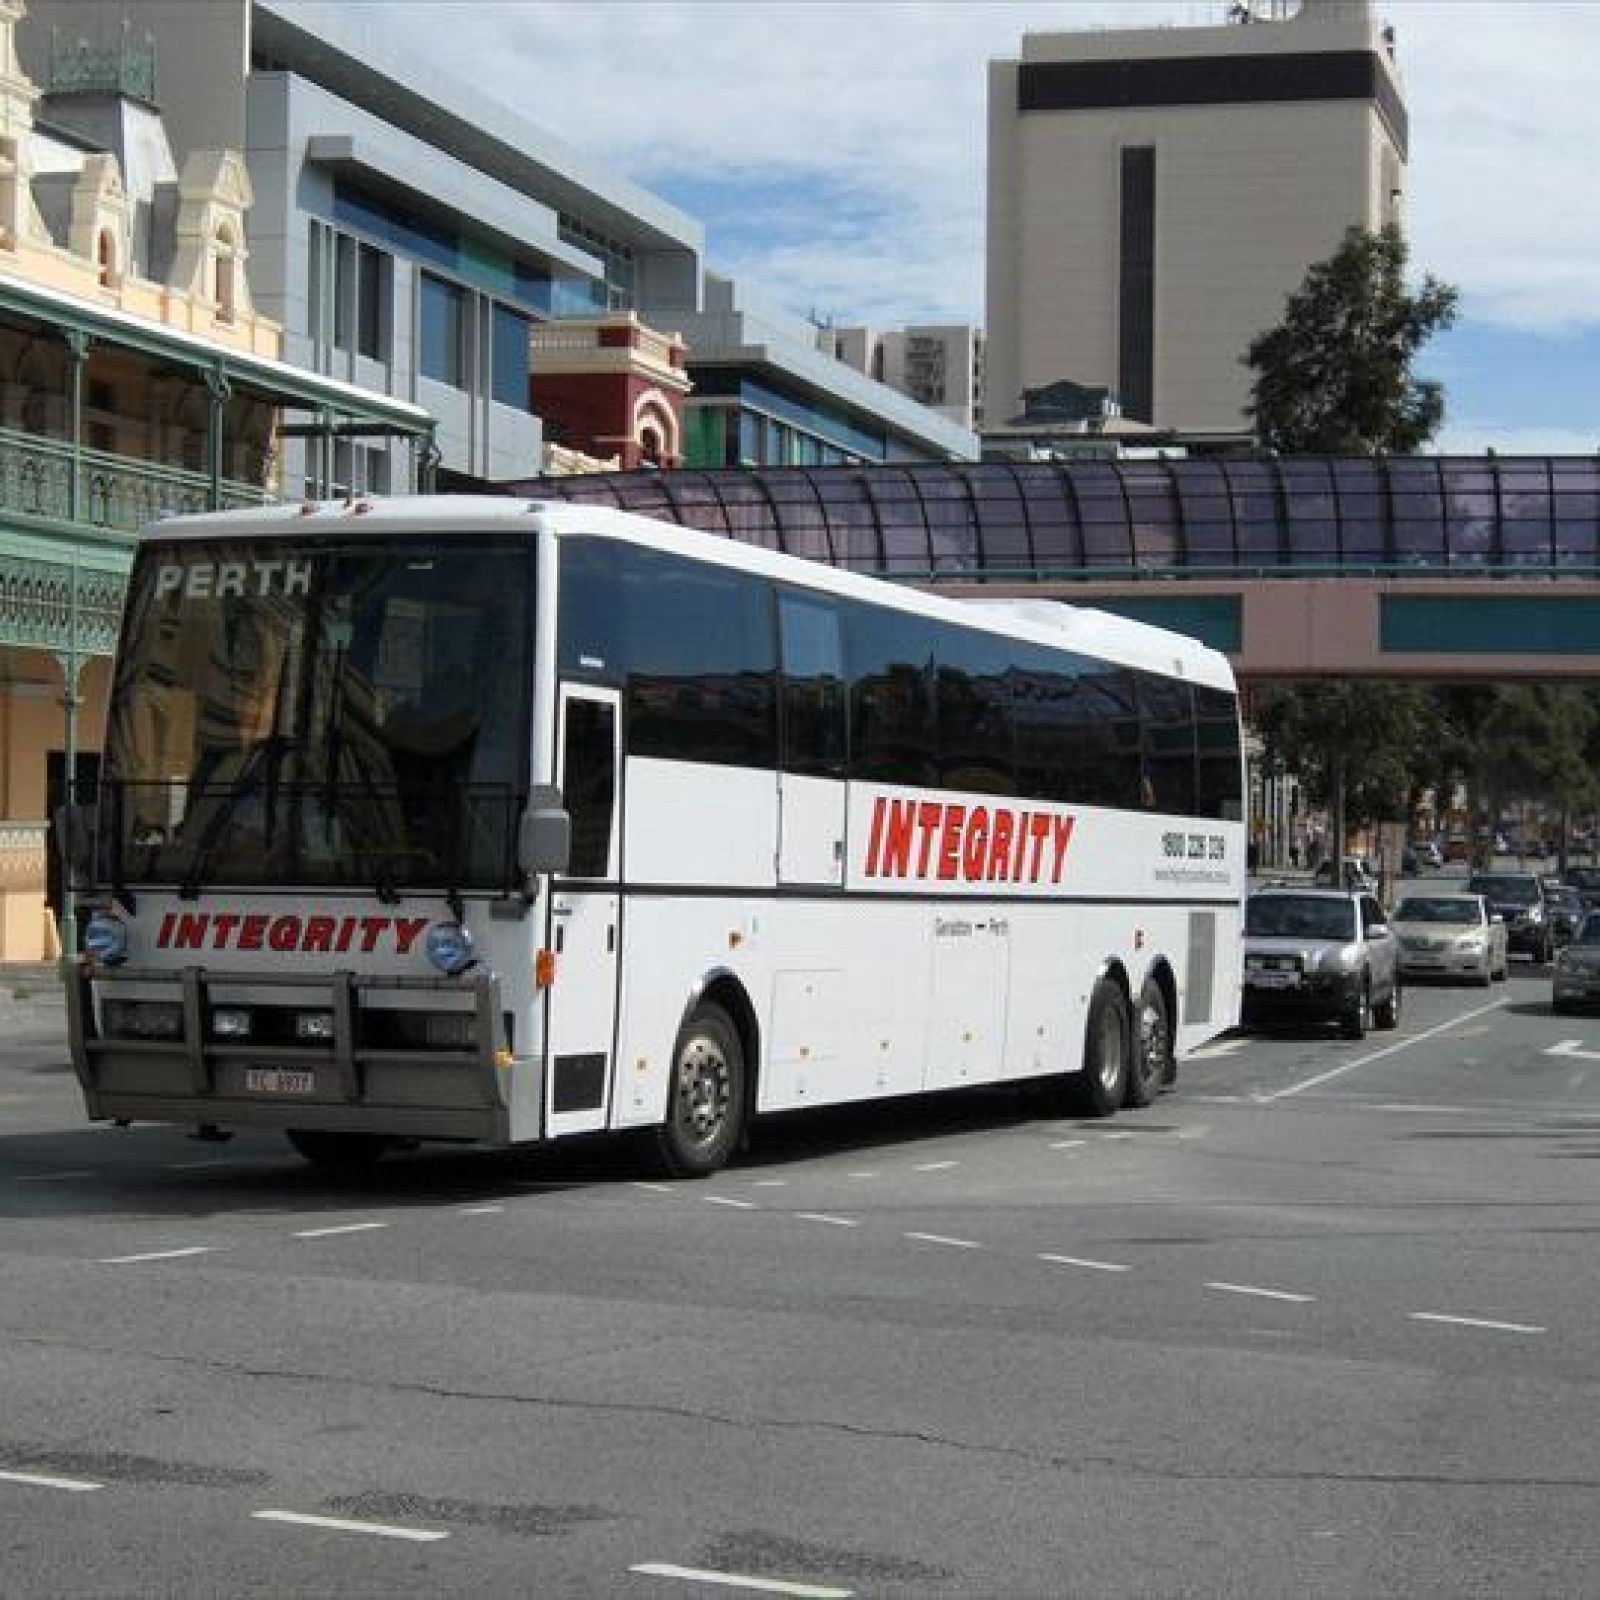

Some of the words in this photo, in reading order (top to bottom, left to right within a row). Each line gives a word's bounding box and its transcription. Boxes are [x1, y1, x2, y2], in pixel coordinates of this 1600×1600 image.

[154, 562, 312, 600] PERTH
[865, 797, 1076, 883] INTEGRITY
[157, 913, 428, 954] INTEGRITY
